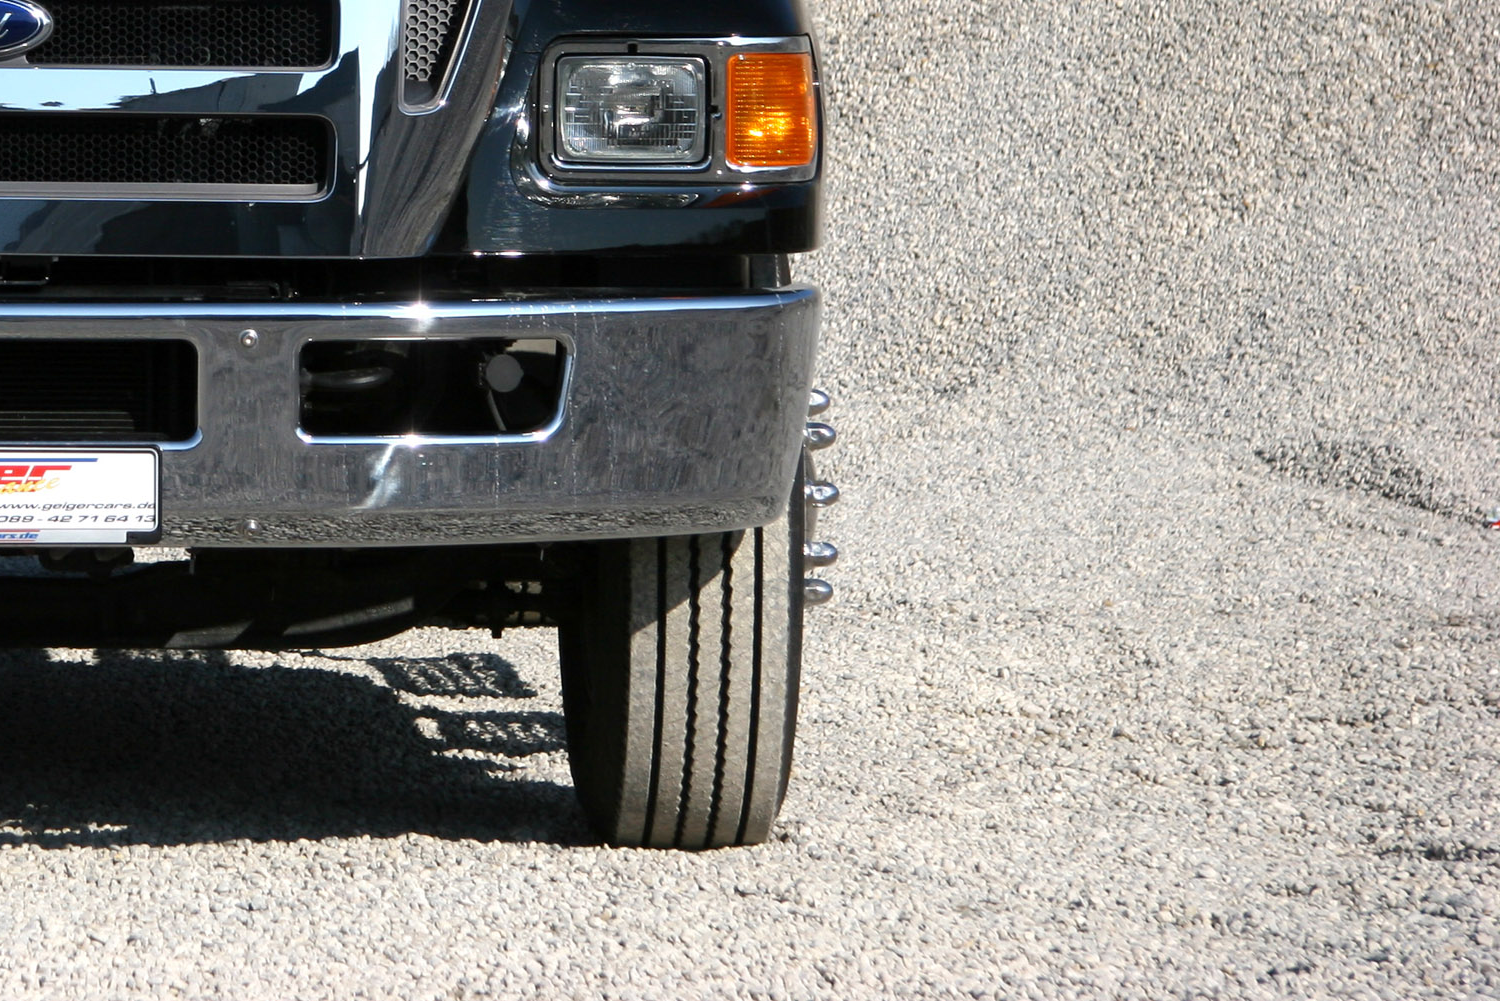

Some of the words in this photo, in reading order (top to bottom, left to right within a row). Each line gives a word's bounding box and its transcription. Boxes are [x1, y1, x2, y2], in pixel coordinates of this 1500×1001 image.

[47, 514, 73, 523] 42
[78, 514, 99, 523] 71
[103, 514, 130, 523] 64
[134, 514, 156, 523] 13
